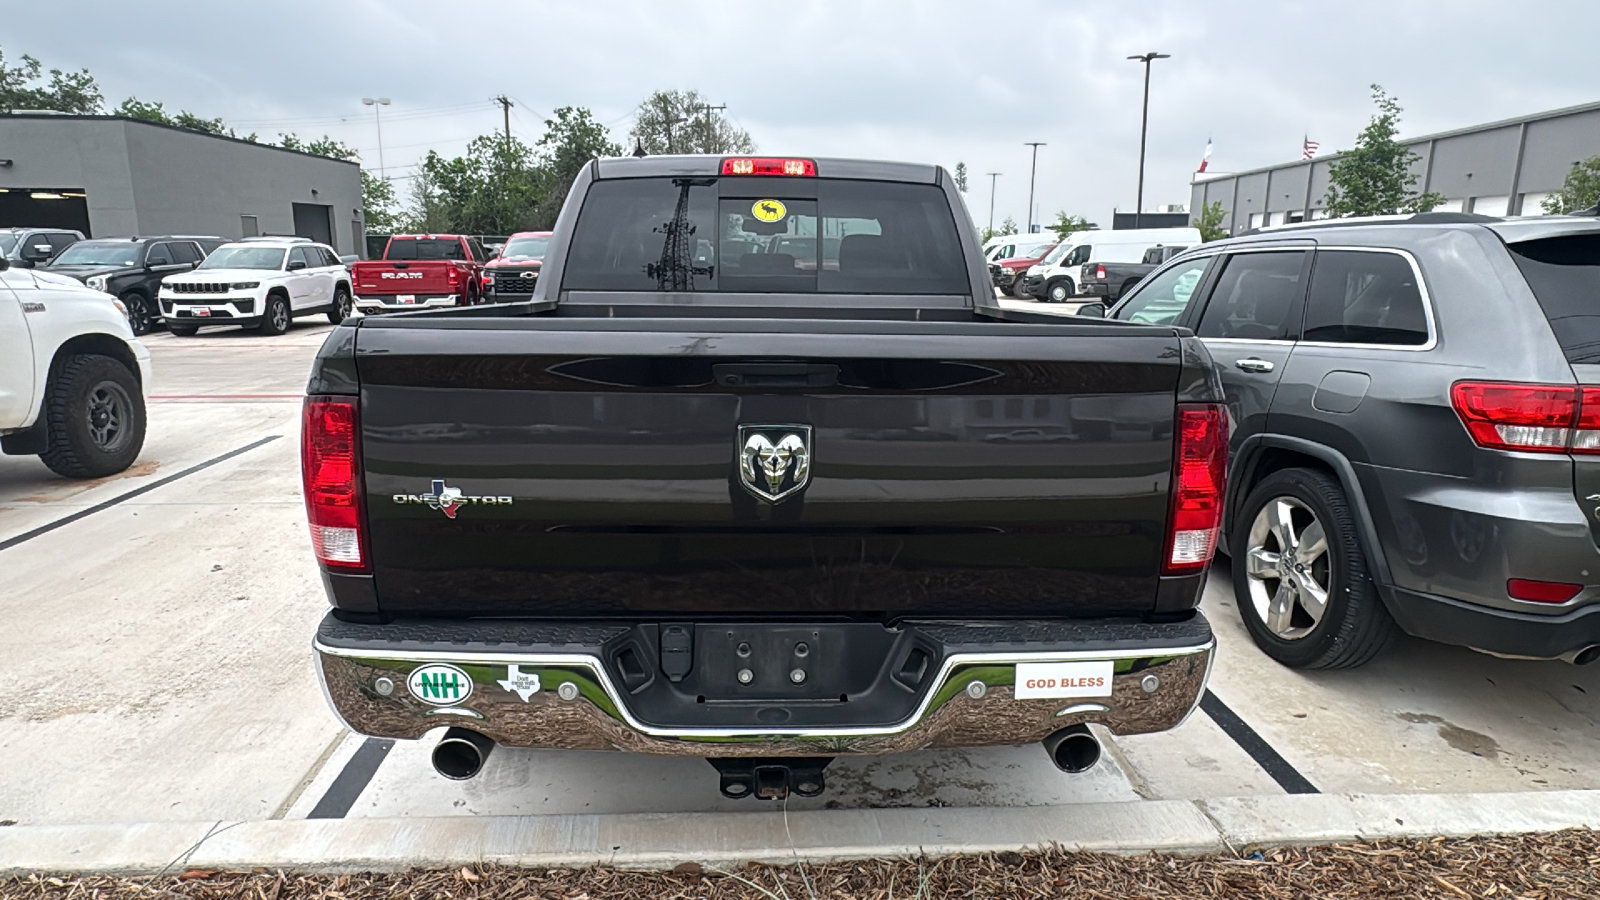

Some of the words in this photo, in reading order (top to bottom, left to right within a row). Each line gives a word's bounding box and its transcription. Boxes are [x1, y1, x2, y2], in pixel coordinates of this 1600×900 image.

[421, 672, 459, 698] NH
[1026, 679, 1056, 689] GOD
[1060, 677, 1104, 688] BLESS
